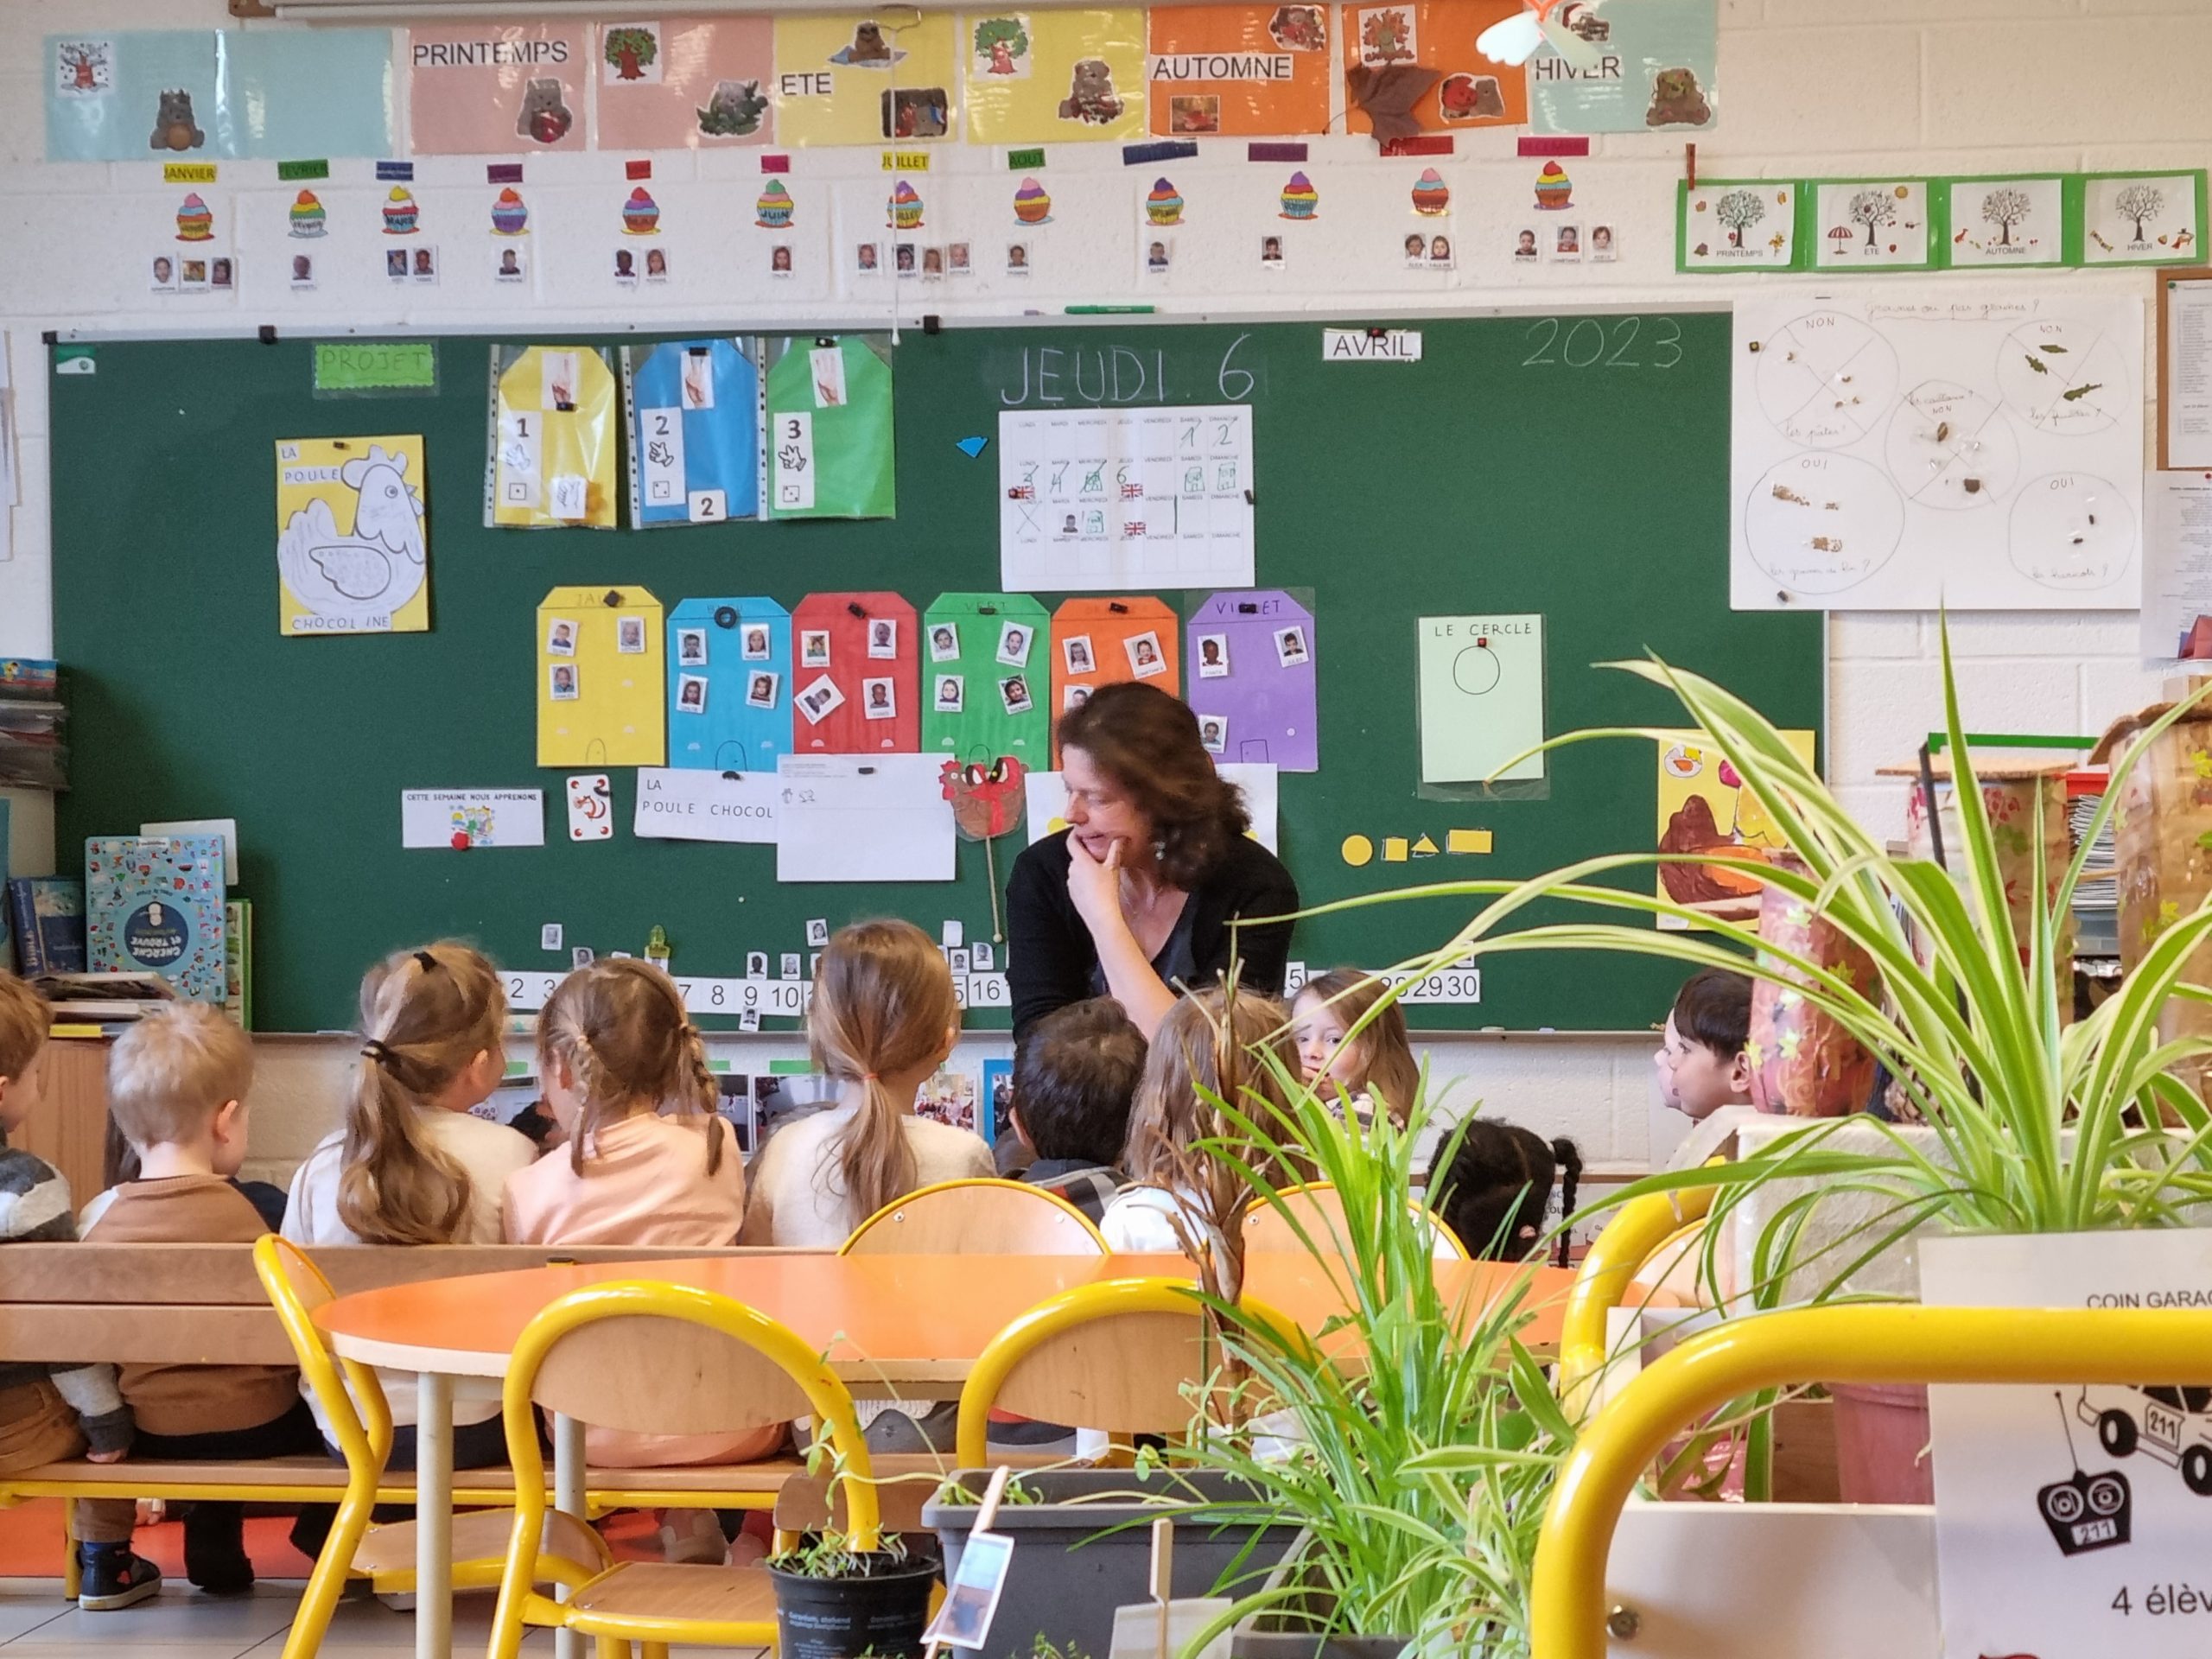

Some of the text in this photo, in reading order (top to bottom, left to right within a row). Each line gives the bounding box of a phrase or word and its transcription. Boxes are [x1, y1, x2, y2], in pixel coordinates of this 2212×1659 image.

[411, 41, 568, 67] PRINTEMPS
[1154, 55, 1292, 79] AUTOMNE
[781, 72, 832, 96] ETE
[164, 166, 216, 180] JANVIER
[1986, 246, 2025, 256] AUTOMNE
[2127, 243, 2152, 251] HIVER
[1806, 317, 1835, 329] NON
[2040, 325, 2062, 334] NON
[1333, 334, 1412, 359] AVRIL
[1522, 317, 1684, 369] 2023
[321, 350, 428, 372] PROJET
[1001, 334, 1255, 404] JEUDI 6
[1932, 404, 1952, 414] NON
[517, 418, 530, 437] 1
[655, 416, 670, 435] 2
[788, 420, 801, 439] 3
[1218, 423, 1233, 446] 2
[281, 448, 297, 460] LA
[1802, 459, 1827, 469] OUI
[284, 468, 339, 482] POULE
[1116, 466, 1129, 485] 6
[2050, 477, 2074, 490] OUI
[701, 498, 715, 516] 2
[1217, 600, 1281, 614] VIET
[1434, 622, 1533, 637] LE CERCLE
[647, 779, 662, 791] LA
[642, 801, 773, 818] POULE CHOCOL
[511, 978, 524, 998] 2
[711, 984, 724, 1005] 8
[745, 986, 758, 1006] 9
[772, 987, 798, 1008] 10
[973, 980, 1000, 1001] 16
[1413, 976, 1443, 996] 29
[1447, 976, 1477, 996] 30
[2087, 1293, 2139, 1308] COIN
[2149, 1412, 2178, 1441] 211
[2079, 1521, 2113, 1544] 211
[2112, 1586, 2133, 1615] 4
